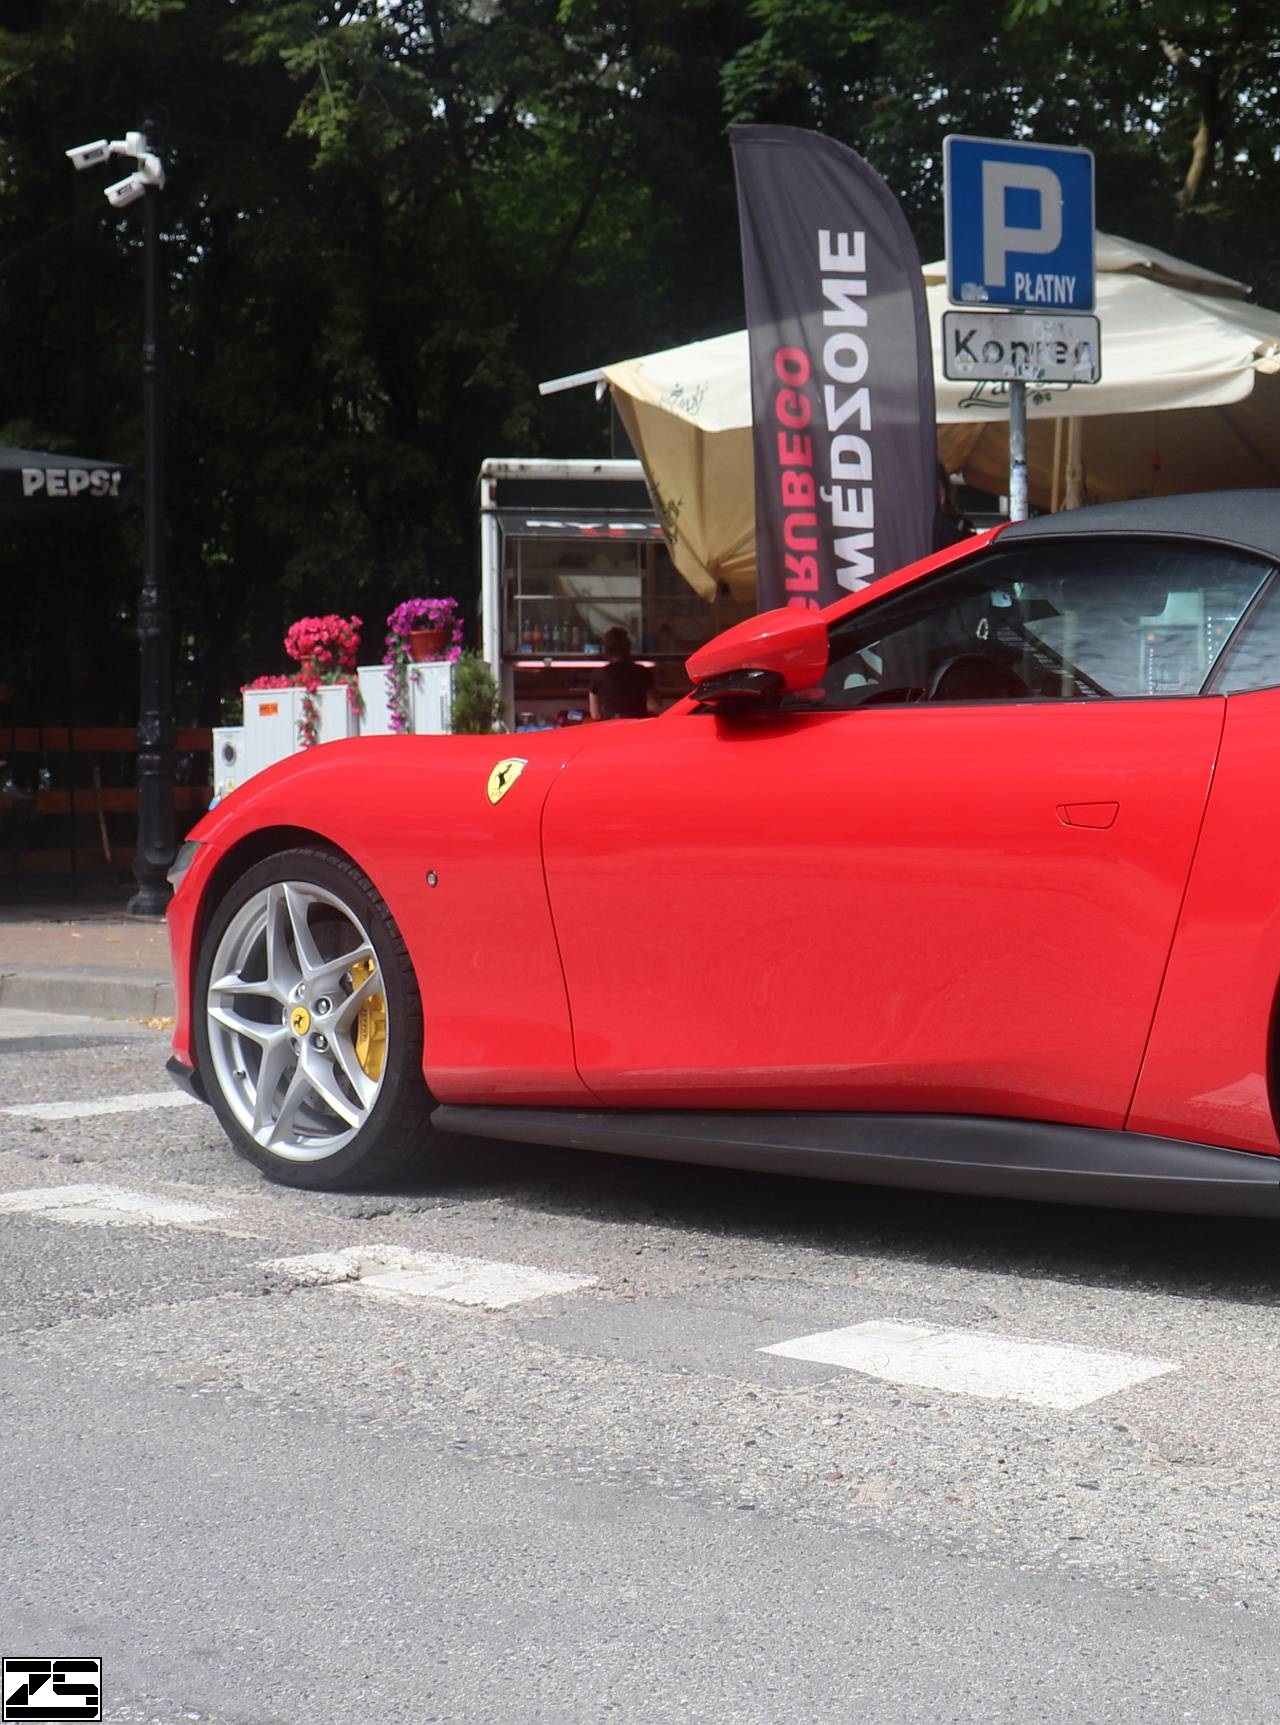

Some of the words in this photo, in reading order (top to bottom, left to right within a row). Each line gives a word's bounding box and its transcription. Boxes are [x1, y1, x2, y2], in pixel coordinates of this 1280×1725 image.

[981, 160, 1062, 288] P
[1014, 271, 1077, 305] PŁATNY
[21, 468, 122, 497] PEPSI
